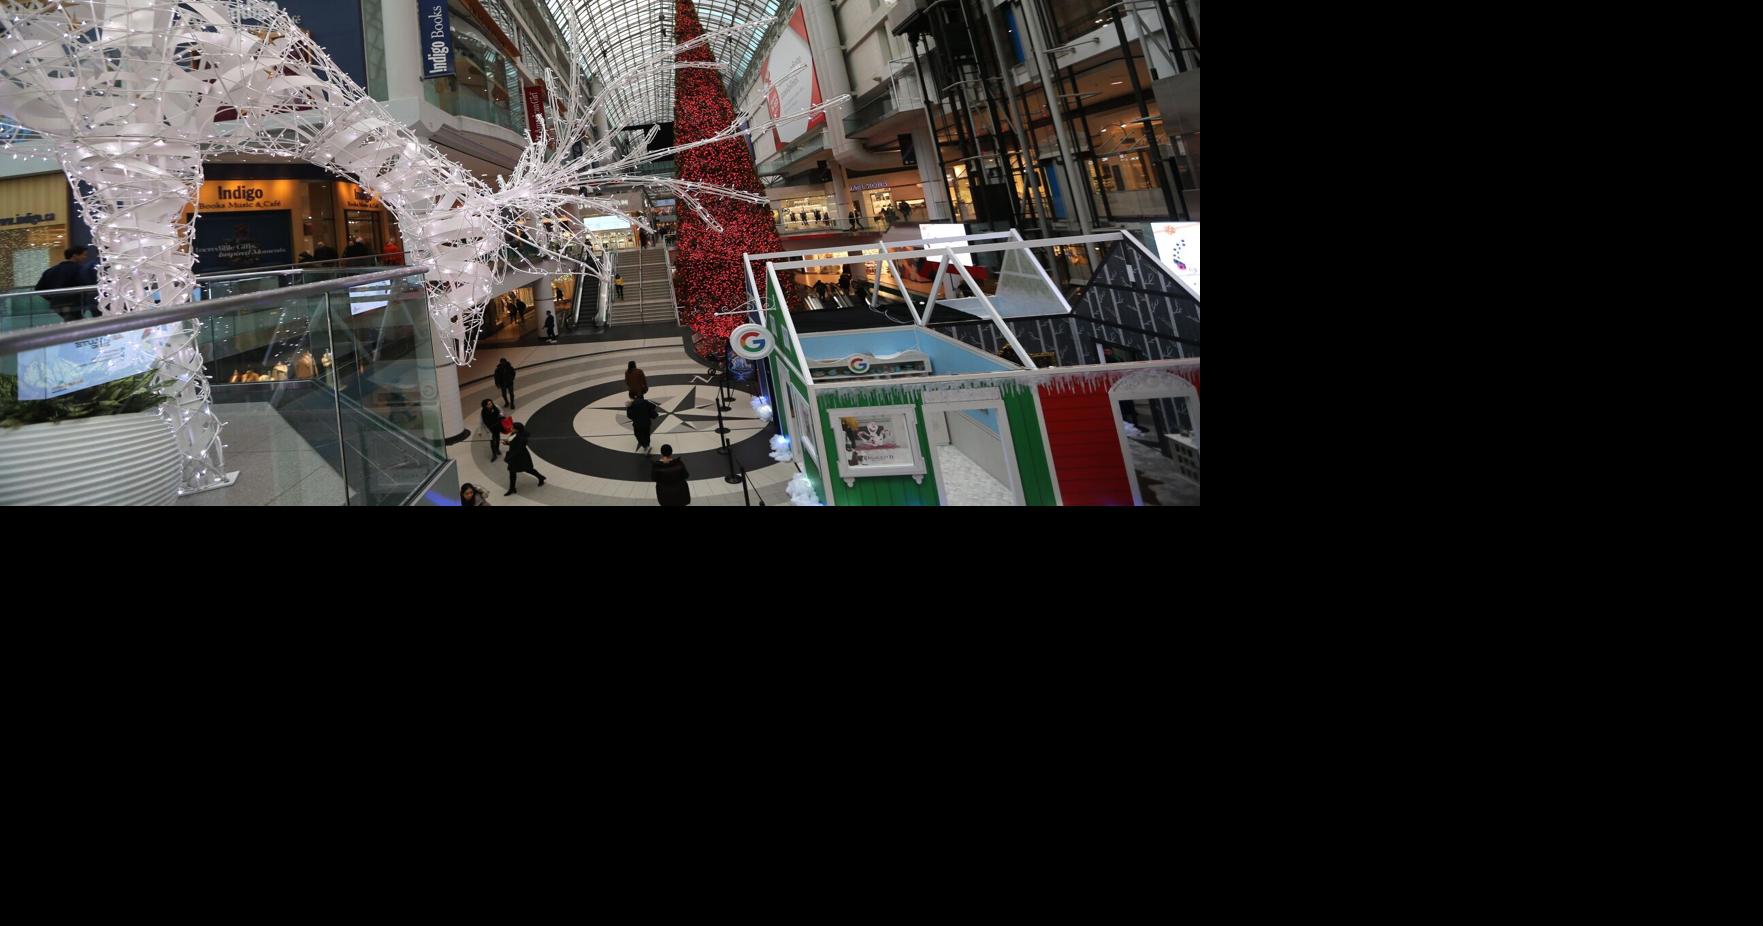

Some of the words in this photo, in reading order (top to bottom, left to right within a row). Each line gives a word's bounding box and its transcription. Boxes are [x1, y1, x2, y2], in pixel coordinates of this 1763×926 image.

[428, 5, 445, 39] Books
[428, 41, 449, 73] Indigo
[217, 185, 264, 201] Indigo
[739, 331, 766, 353] G
